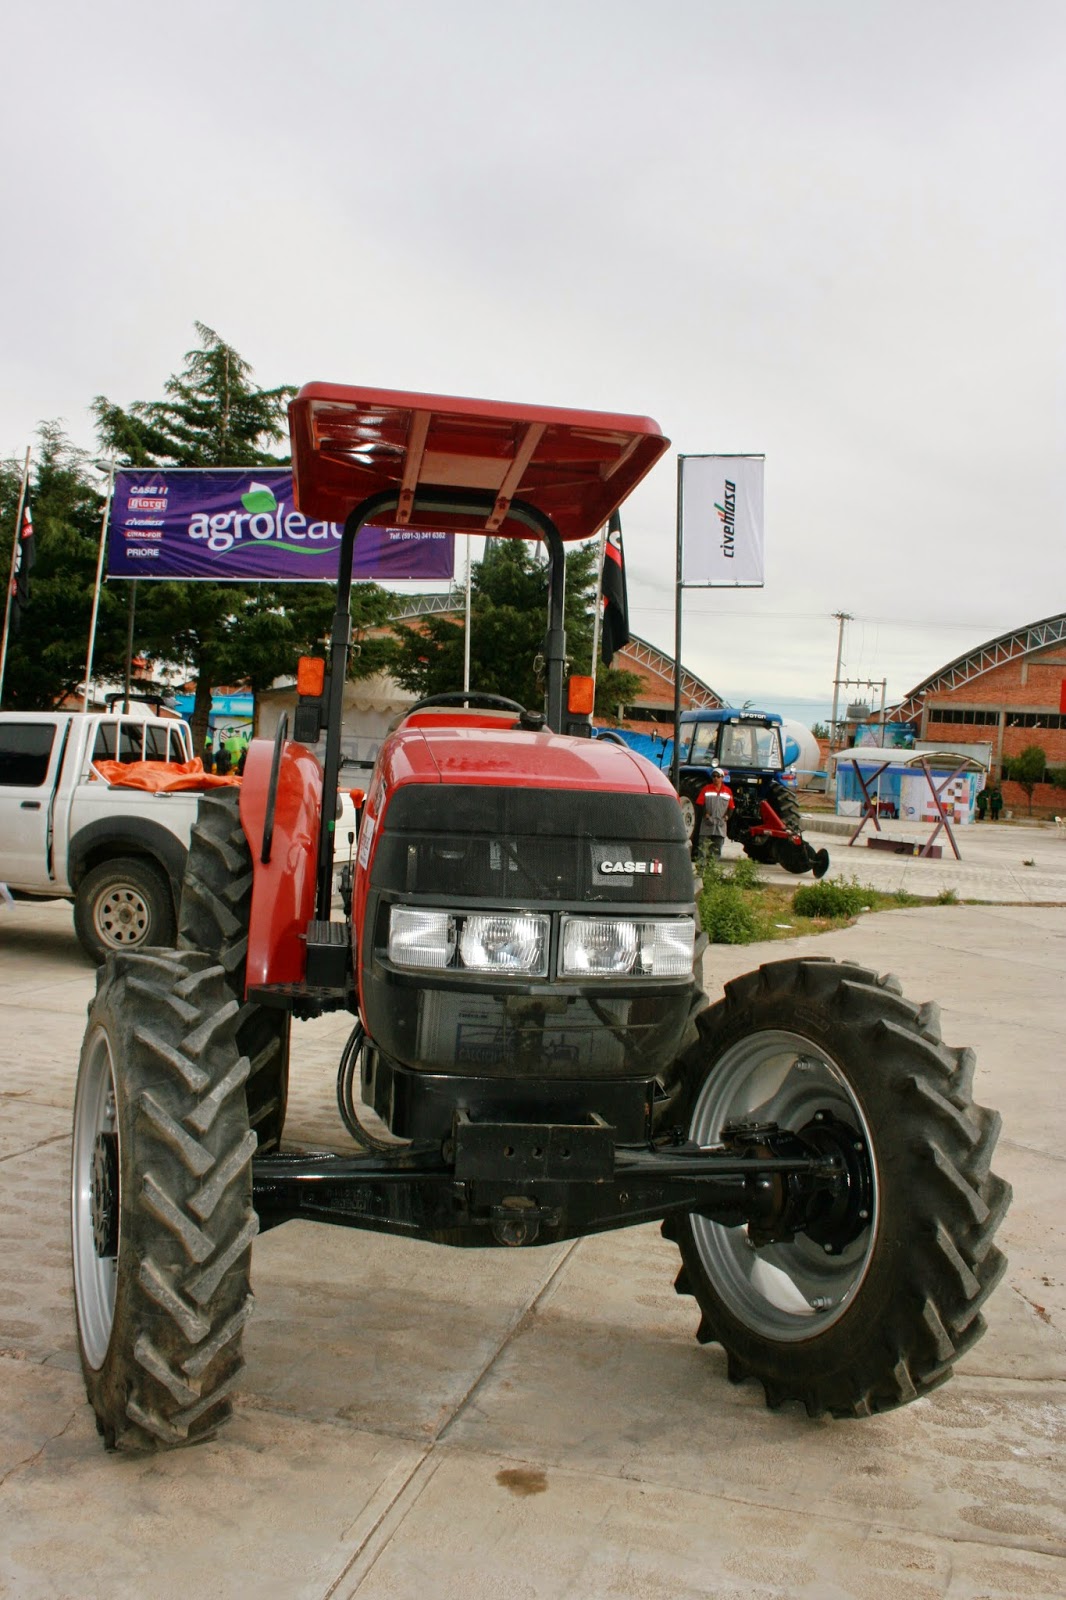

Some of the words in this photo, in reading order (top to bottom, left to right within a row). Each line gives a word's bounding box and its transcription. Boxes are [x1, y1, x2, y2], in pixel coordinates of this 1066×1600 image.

[130, 486, 158, 494] CASE
[720, 479, 736, 558] civemasa
[126, 548, 160, 557] PRIORE
[600, 861, 646, 873] CASE
